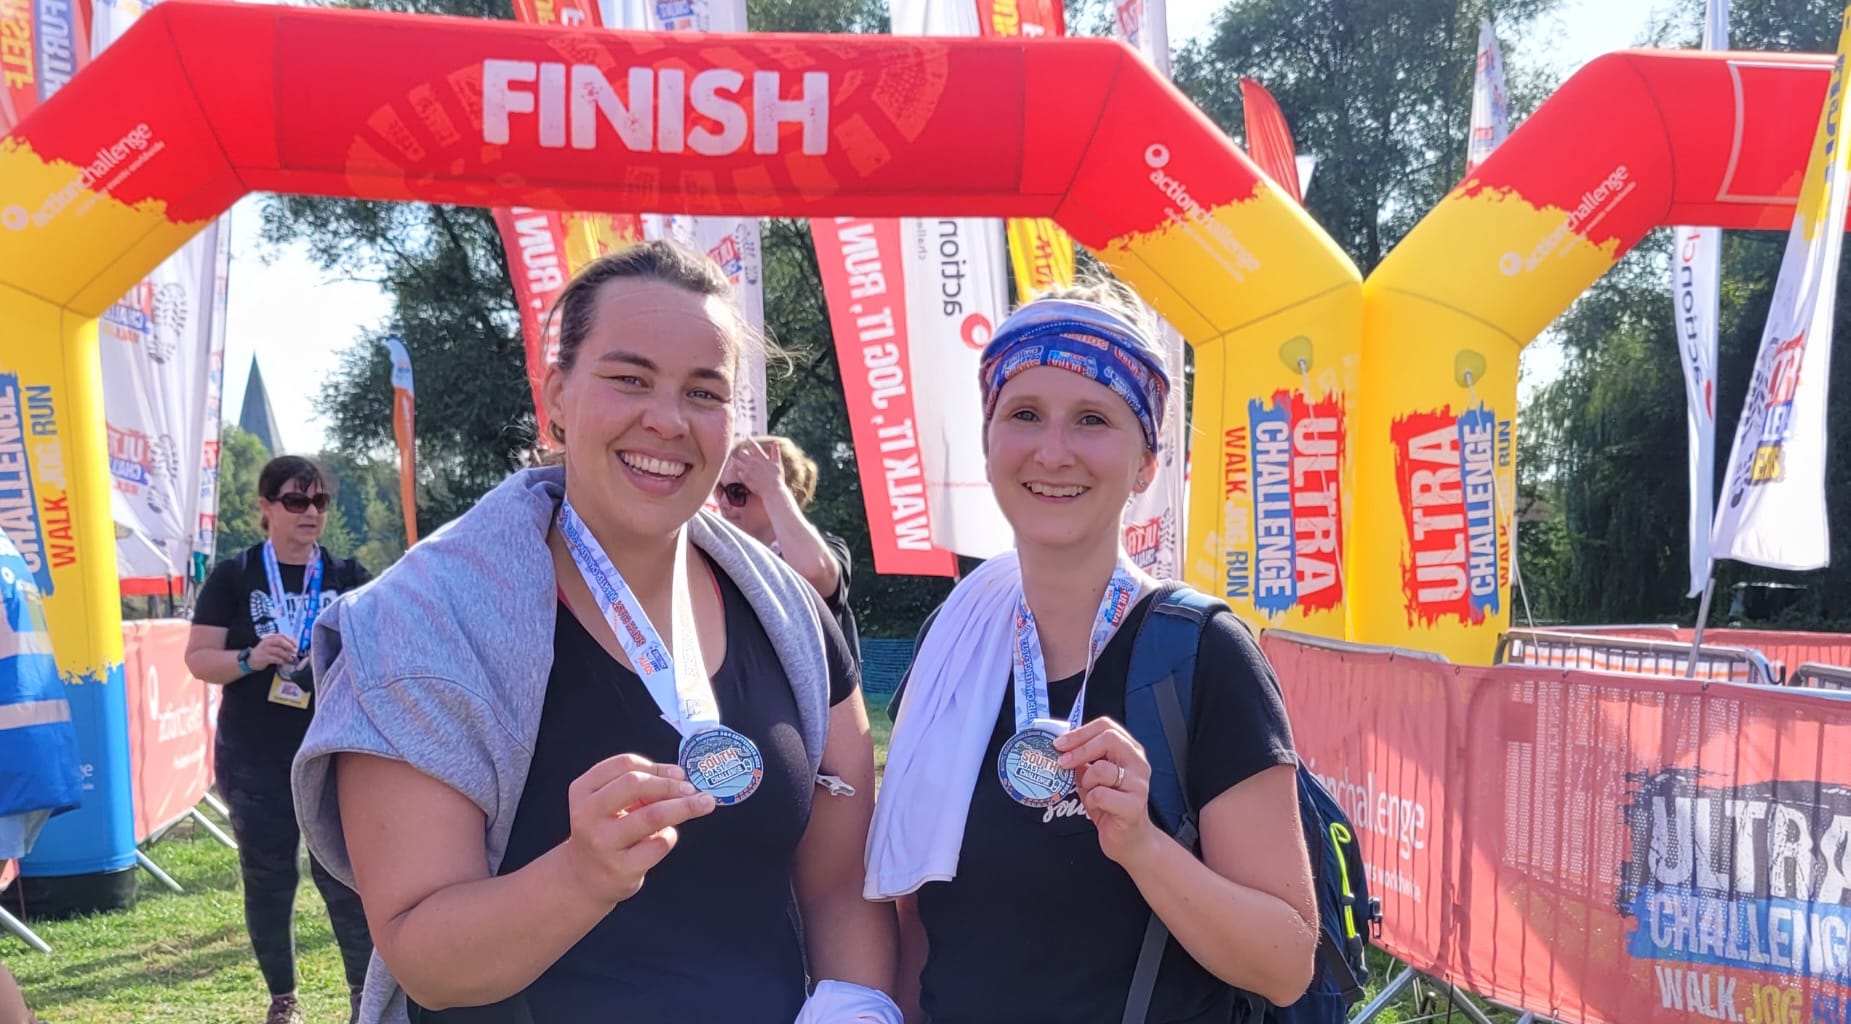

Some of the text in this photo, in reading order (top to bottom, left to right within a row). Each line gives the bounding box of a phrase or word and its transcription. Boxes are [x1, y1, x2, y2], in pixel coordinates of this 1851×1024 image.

[481, 59, 829, 156] FINISH
[1524, 163, 1630, 272] actionchallenge
[25, 385, 58, 436] RUN
[1497, 419, 1512, 468] RUN
[1255, 420, 1292, 598] CHALLENGE
[1292, 416, 1339, 597] ULTRA
[1407, 424, 1469, 603] ULTRA
[1463, 422, 1495, 596] CHALLENGE
[1226, 550, 1249, 598] RUN
[698, 748, 738, 772] SOUTH
[703, 762, 726, 779] COAST
[1018, 760, 1040, 774] COAST
[1019, 768, 1052, 787] CHALLENGE
[1022, 750, 1058, 774] SOUTH
[1650, 894, 1851, 980] CHALLENG
[1654, 966, 1745, 1023] WALK.
